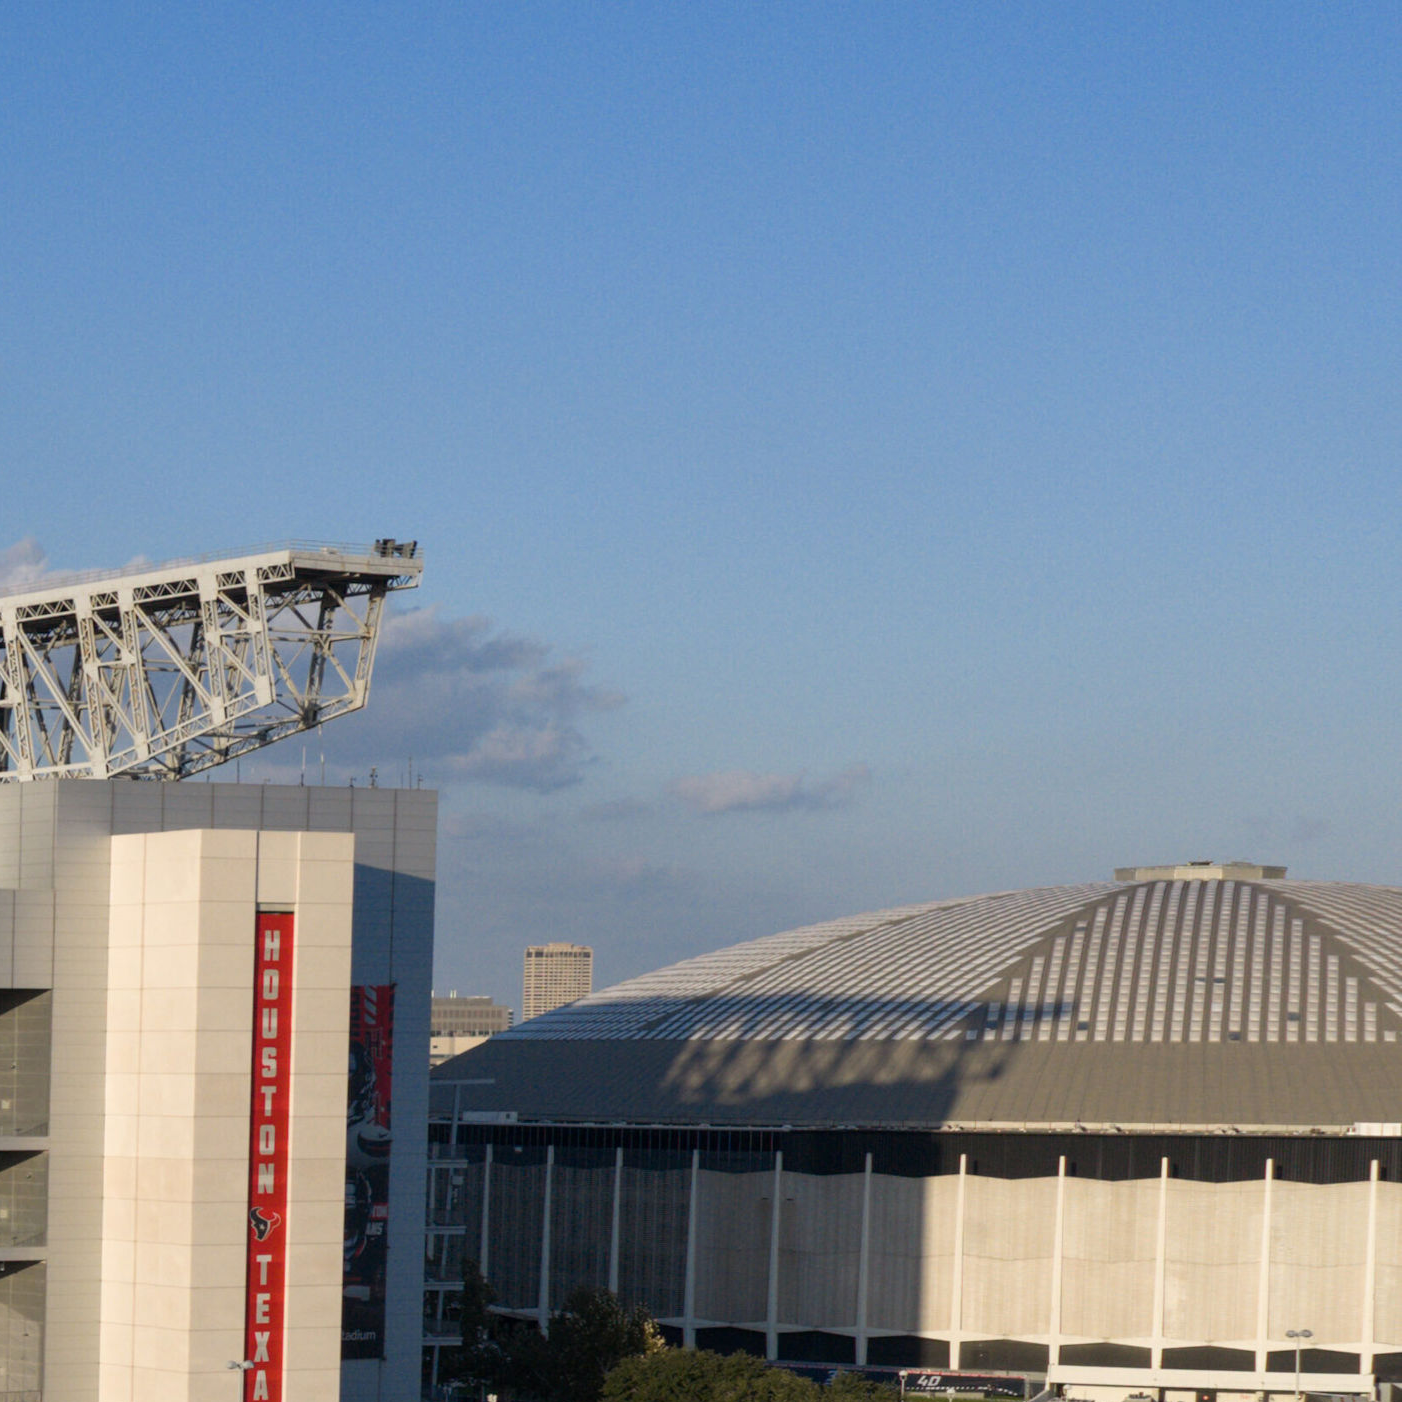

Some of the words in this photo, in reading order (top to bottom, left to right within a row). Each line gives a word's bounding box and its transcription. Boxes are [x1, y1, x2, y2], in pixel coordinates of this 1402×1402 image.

[257, 929, 281, 1196] HOUSTON
[342, 1329, 376, 1342] tadium
[916, 1374, 942, 1387] 40
